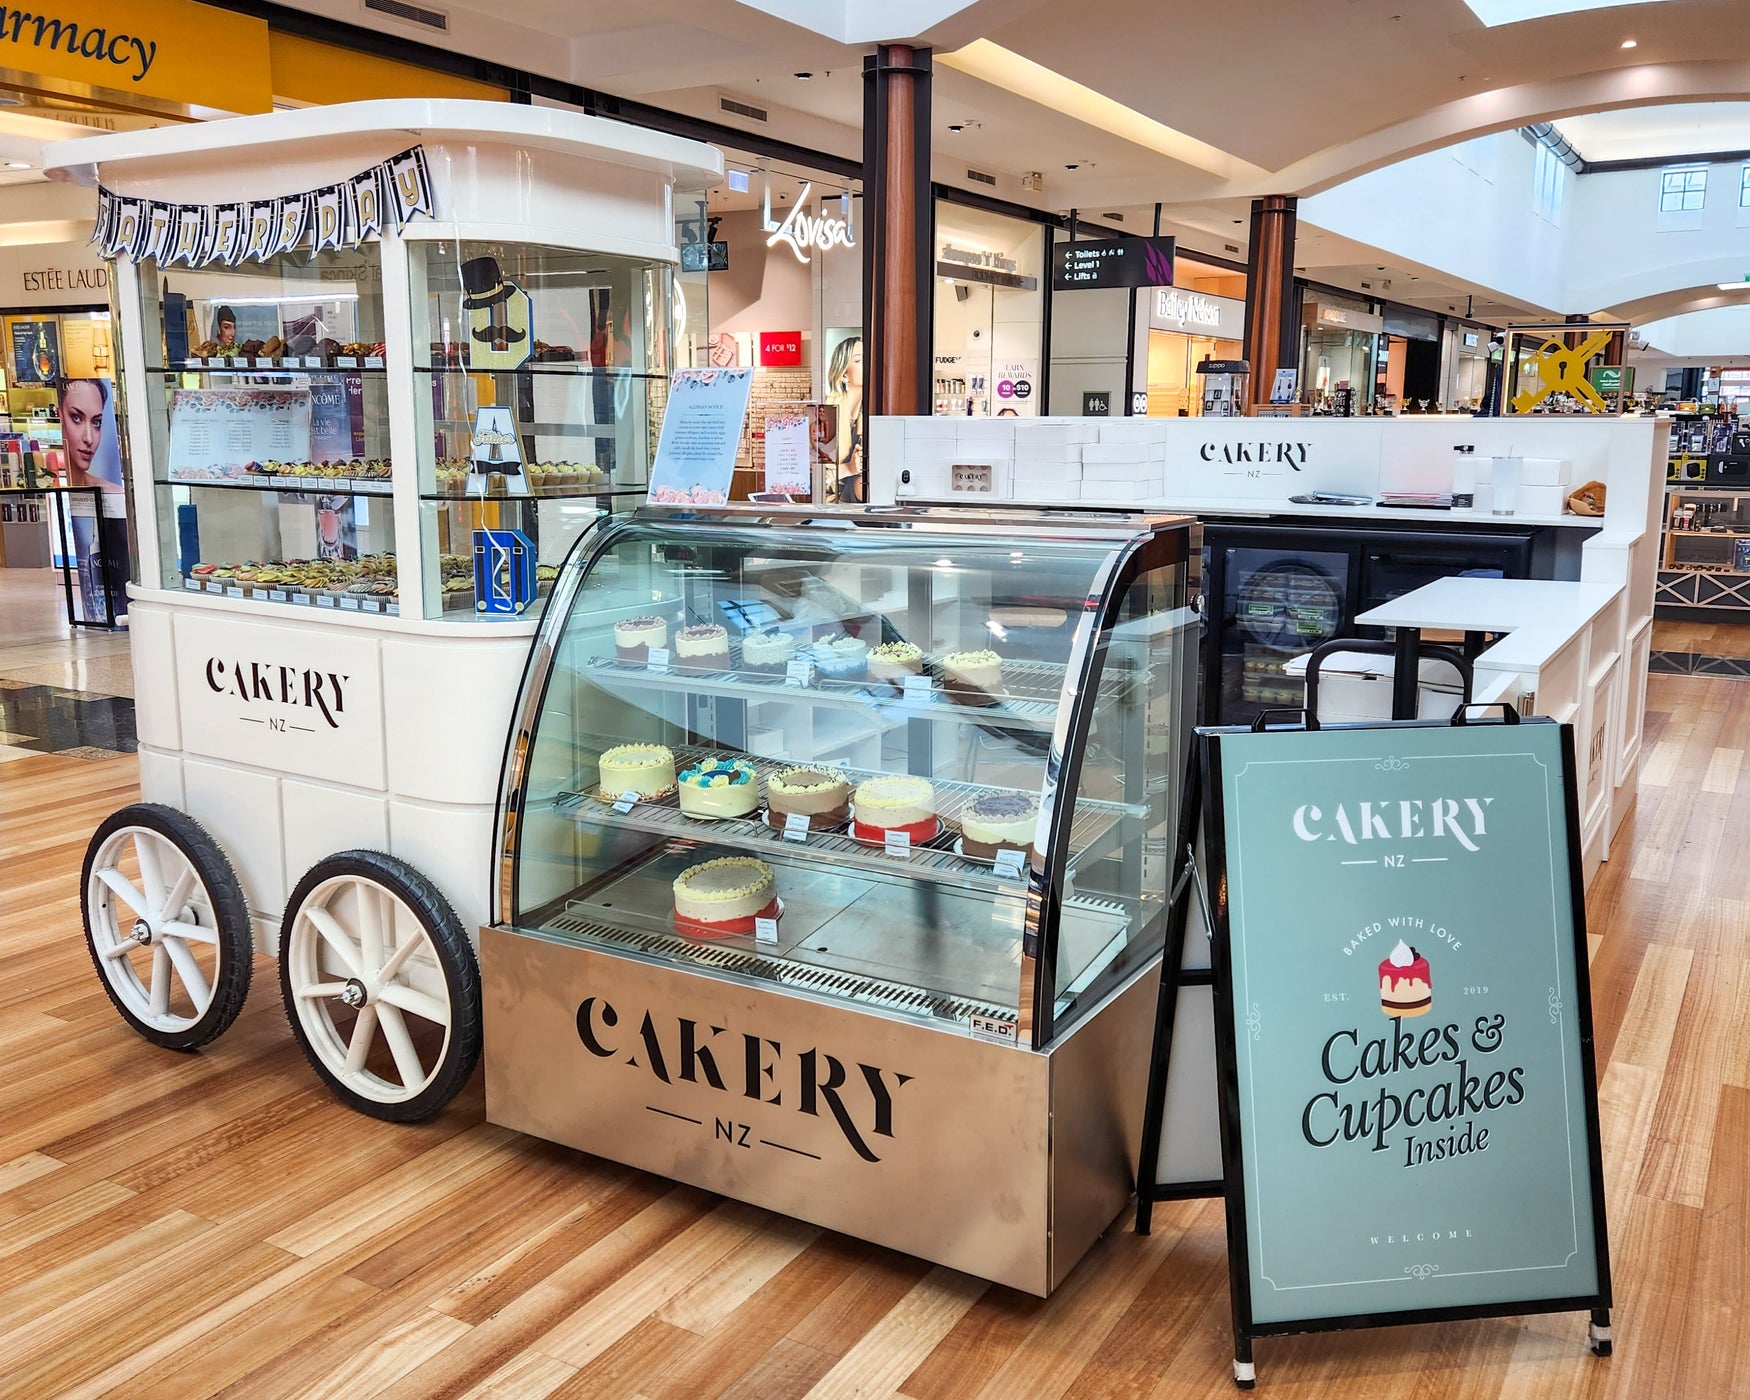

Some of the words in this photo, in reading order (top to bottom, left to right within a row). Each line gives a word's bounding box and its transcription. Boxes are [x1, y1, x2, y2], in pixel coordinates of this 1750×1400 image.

[766, 182, 856, 263] Lovisa
[1074, 261, 1094, 269] Level
[1075, 249, 1100, 259] Toilets
[1073, 272, 1091, 281] Lifts
[1158, 290, 1189, 327] Bailey
[1190, 296, 1221, 326] Nelson
[765, 344, 771, 352] 4
[771, 343, 785, 352] FOR
[786, 343, 797, 352] $12
[998, 371, 1032, 379] REWARDS
[1200, 441, 1314, 472] CAKERY
[1247, 470, 1260, 478] NZ
[205, 657, 350, 728] CAKERY
[269, 717, 286, 732] NZ
[1293, 797, 1495, 852] CAKERY
[1384, 855, 1406, 868] NZ
[1342, 921, 1383, 956] BAKED
[1387, 916, 1425, 929] WITH
[1429, 922, 1463, 952] LOVE
[1323, 993, 1350, 1002] EST.
[1463, 986, 1489, 996] 2019
[1321, 1015, 1462, 1086] Cakes
[1471, 1013, 1508, 1054] &
[575, 996, 915, 1163] CAKERY
[1301, 1060, 1527, 1152] Cupcakes
[715, 1116, 751, 1148] NZ
[1403, 1121, 1491, 1168] Inside
[1370, 1230, 1474, 1246] WELCOME
